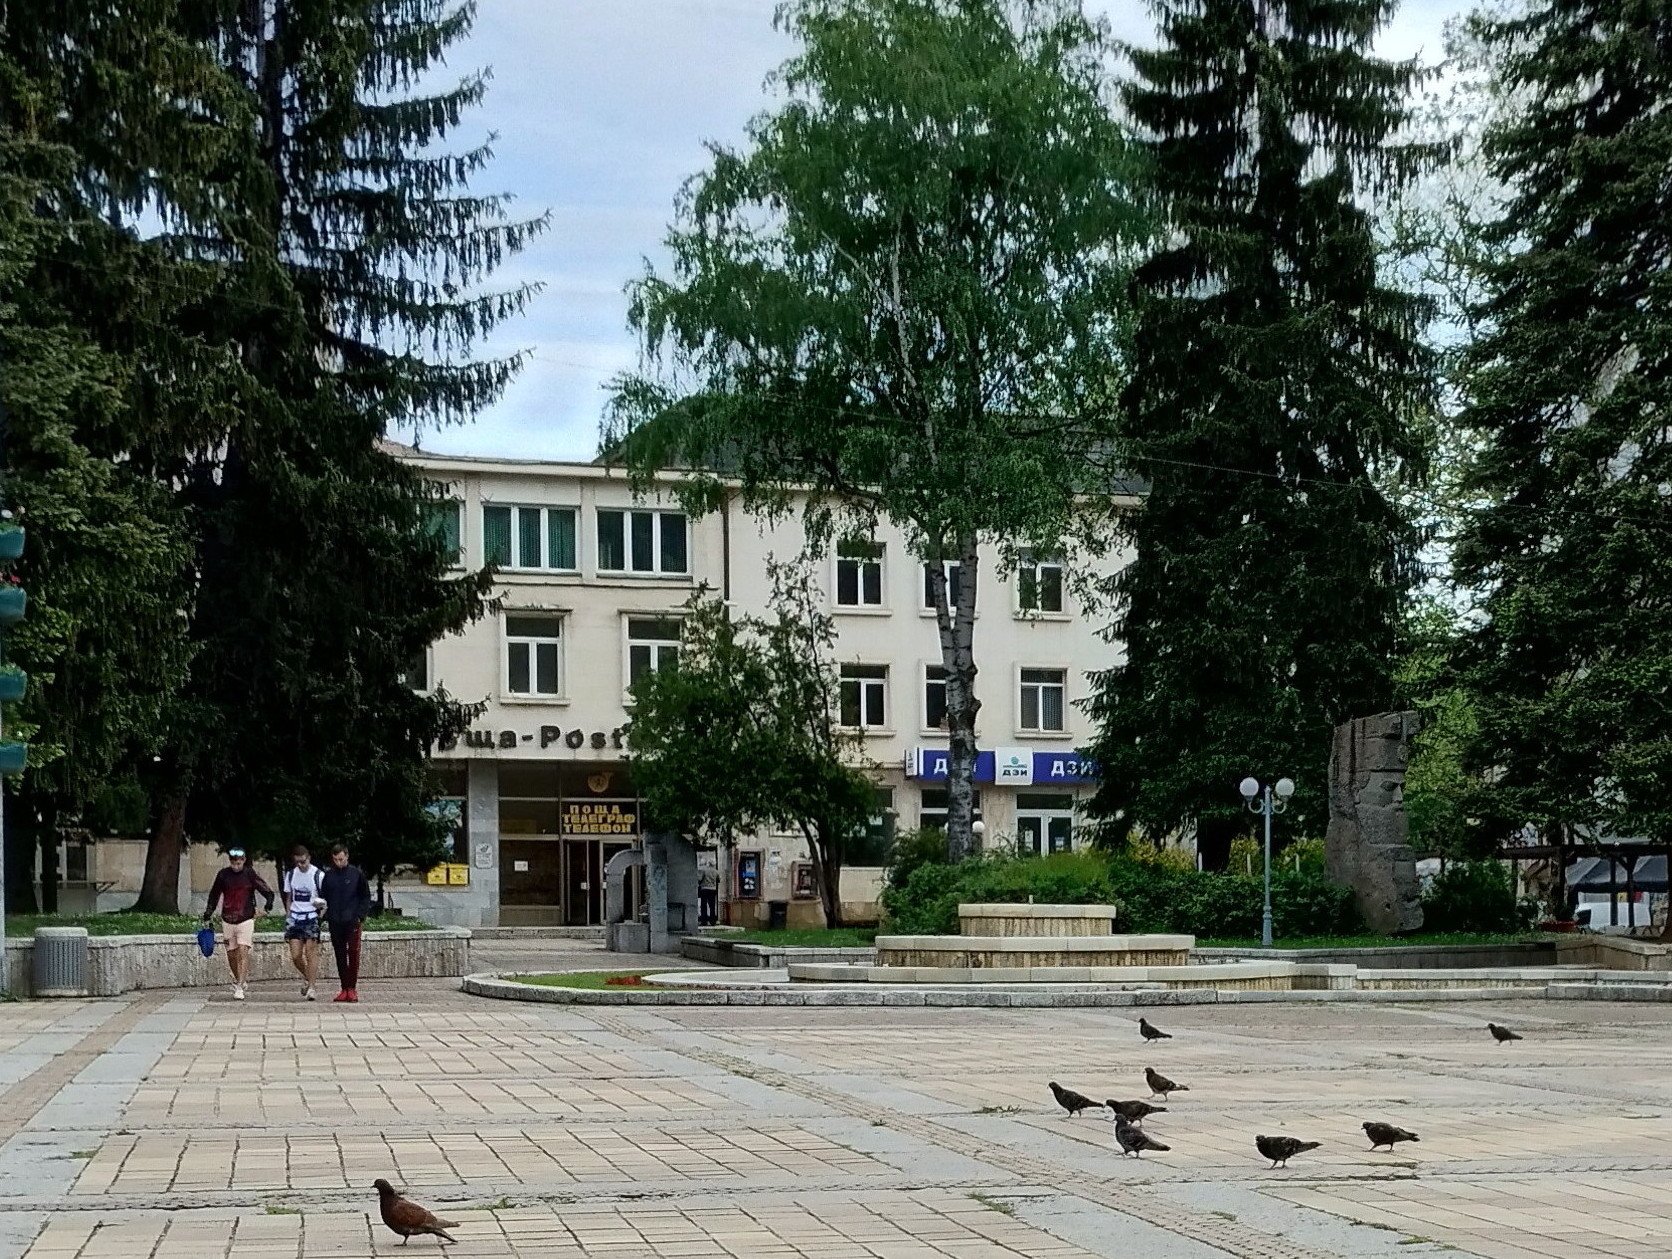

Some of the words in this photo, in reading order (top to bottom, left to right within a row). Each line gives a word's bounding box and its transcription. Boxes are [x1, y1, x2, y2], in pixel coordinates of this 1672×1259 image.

[569, 804, 621, 815] ПОЩА
[562, 814, 636, 823] ТЕЛЕГРАФ
[563, 823, 631, 833] ТЕЛЕФОН
